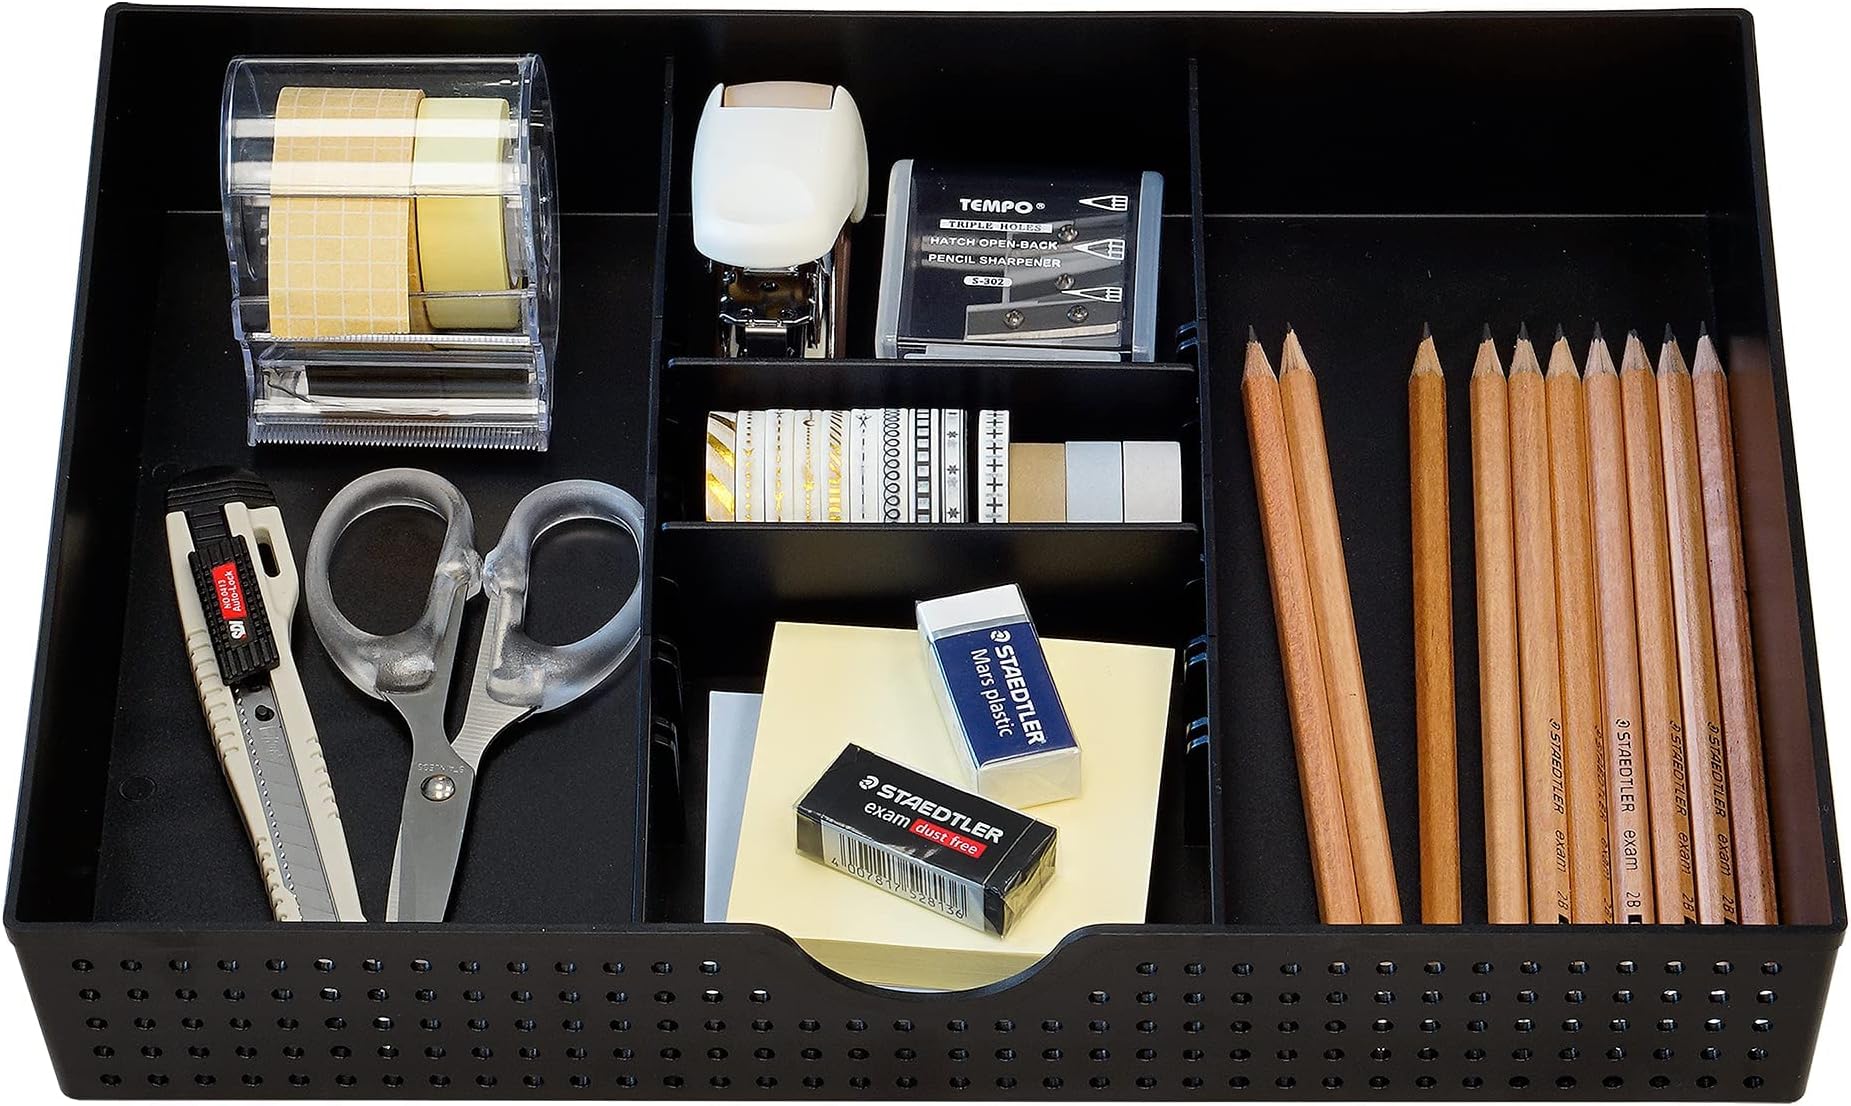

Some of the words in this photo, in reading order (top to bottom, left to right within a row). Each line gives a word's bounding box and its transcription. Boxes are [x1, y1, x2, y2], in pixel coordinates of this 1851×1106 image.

[930, 237, 977, 247] HATCH
[979, 238, 1058, 250] OPEN-BACK
[949, 221, 994, 230] TRIPLE
[1000, 223, 1042, 232] HOLES
[928, 253, 976, 264] PENCIL
[979, 255, 1062, 268] SHARPENER
[972, 277, 1005, 286] S-302
[225, 570, 242, 612] Auto-Lock
[229, 620, 246, 640] SDI
[971, 648, 995, 687] Mars
[980, 690, 1014, 738] plastic
[417, 763, 465, 774] STANLESS
[1549, 732, 1565, 815] STAEDTLER
[1616, 731, 1636, 813] STAEDTLER
[1670, 735, 1688, 816] STAEDTLER
[1707, 735, 1726, 818] STAEDTLER
[863, 800, 912, 829] exam
[915, 823, 949, 844] dust
[950, 836, 979, 856] free
[876, 784, 1005, 844] STAEDTLER
[1555, 830, 1567, 872] exam
[1623, 829, 1638, 871] exam
[1678, 832, 1692, 875] exam
[1718, 833, 1732, 876] exam
[1557, 891, 1569, 911] 2B
[1626, 891, 1641, 908] 2B
[1682, 892, 1695, 913] 2B
[1722, 895, 1735, 914] 2B
